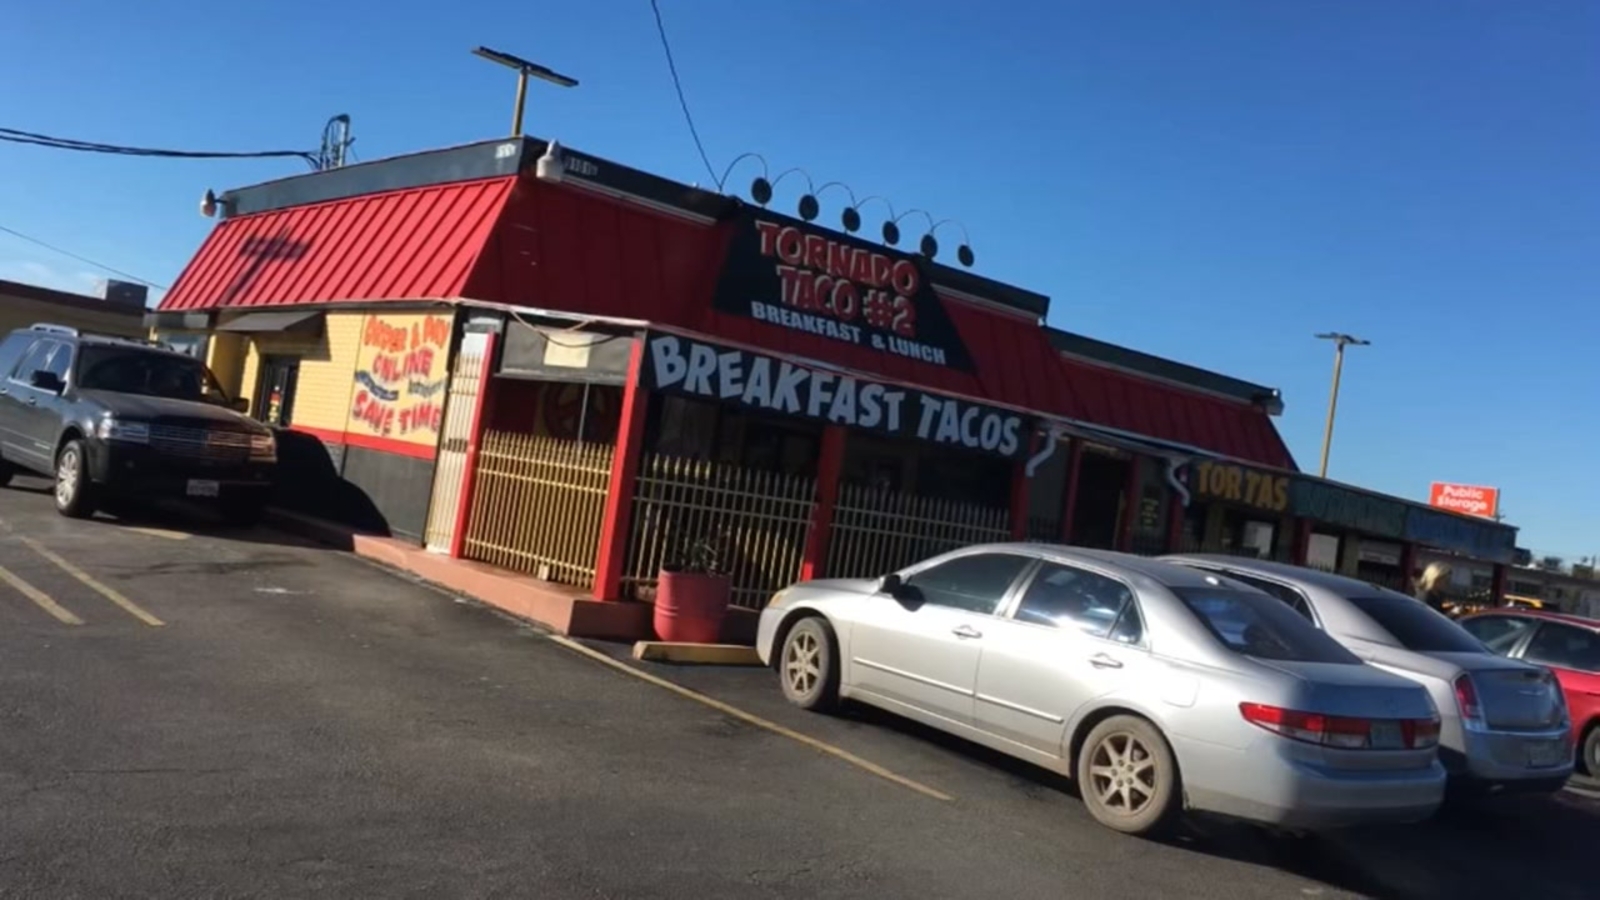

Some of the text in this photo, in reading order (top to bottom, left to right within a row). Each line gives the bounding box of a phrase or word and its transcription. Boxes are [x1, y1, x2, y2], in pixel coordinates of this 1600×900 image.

[755, 220, 919, 296] TORNADO
[776, 265, 915, 337] TACO #2
[751, 301, 946, 365] BREAKFAST & LUNCH
[373, 346, 433, 383] ONLINE
[353, 390, 441, 435] SAVE TIME
[651, 335, 1021, 456] BREAKFAST TACOS
[1197, 461, 1289, 511] TORTAS
[1437, 495, 1487, 512] Storage
[1443, 485, 1484, 500] Public
